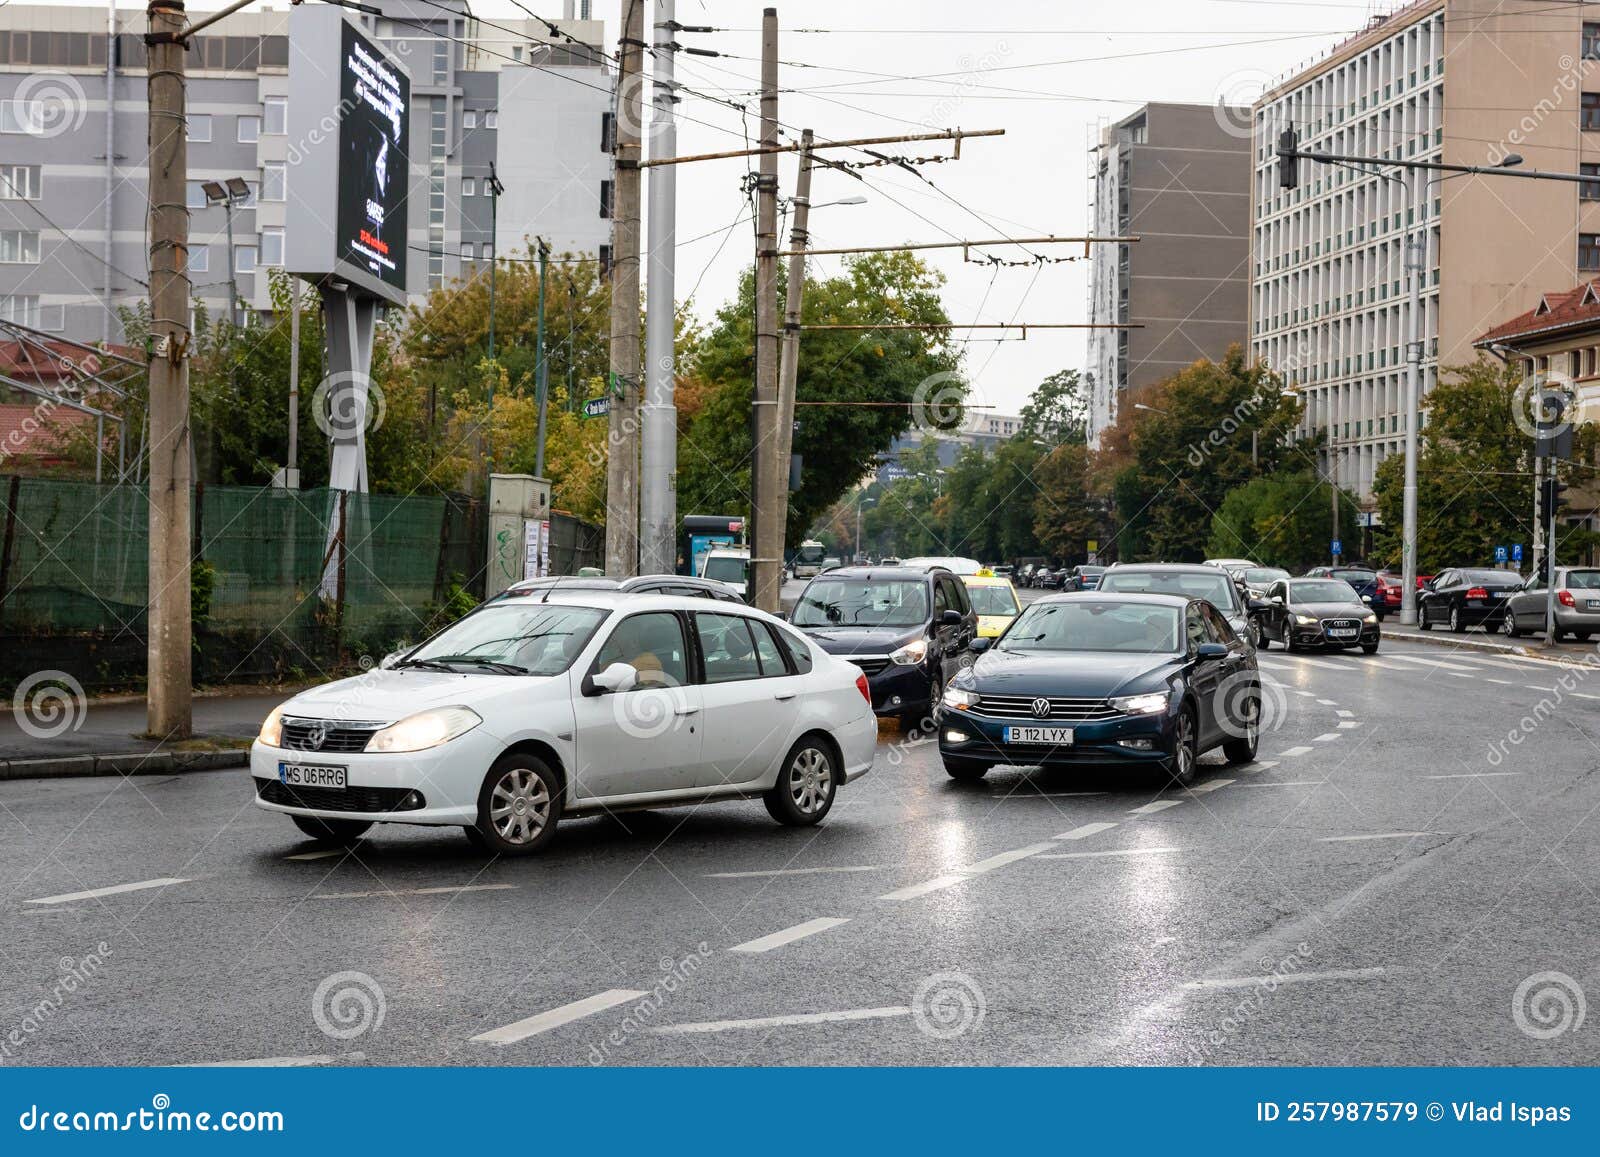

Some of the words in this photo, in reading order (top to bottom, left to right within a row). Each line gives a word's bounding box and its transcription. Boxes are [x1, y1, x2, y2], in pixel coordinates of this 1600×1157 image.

[1011, 728, 1020, 740] B
[1024, 729, 1040, 741] 112
[1042, 729, 1067, 741] LYX
[286, 767, 301, 783] MS
